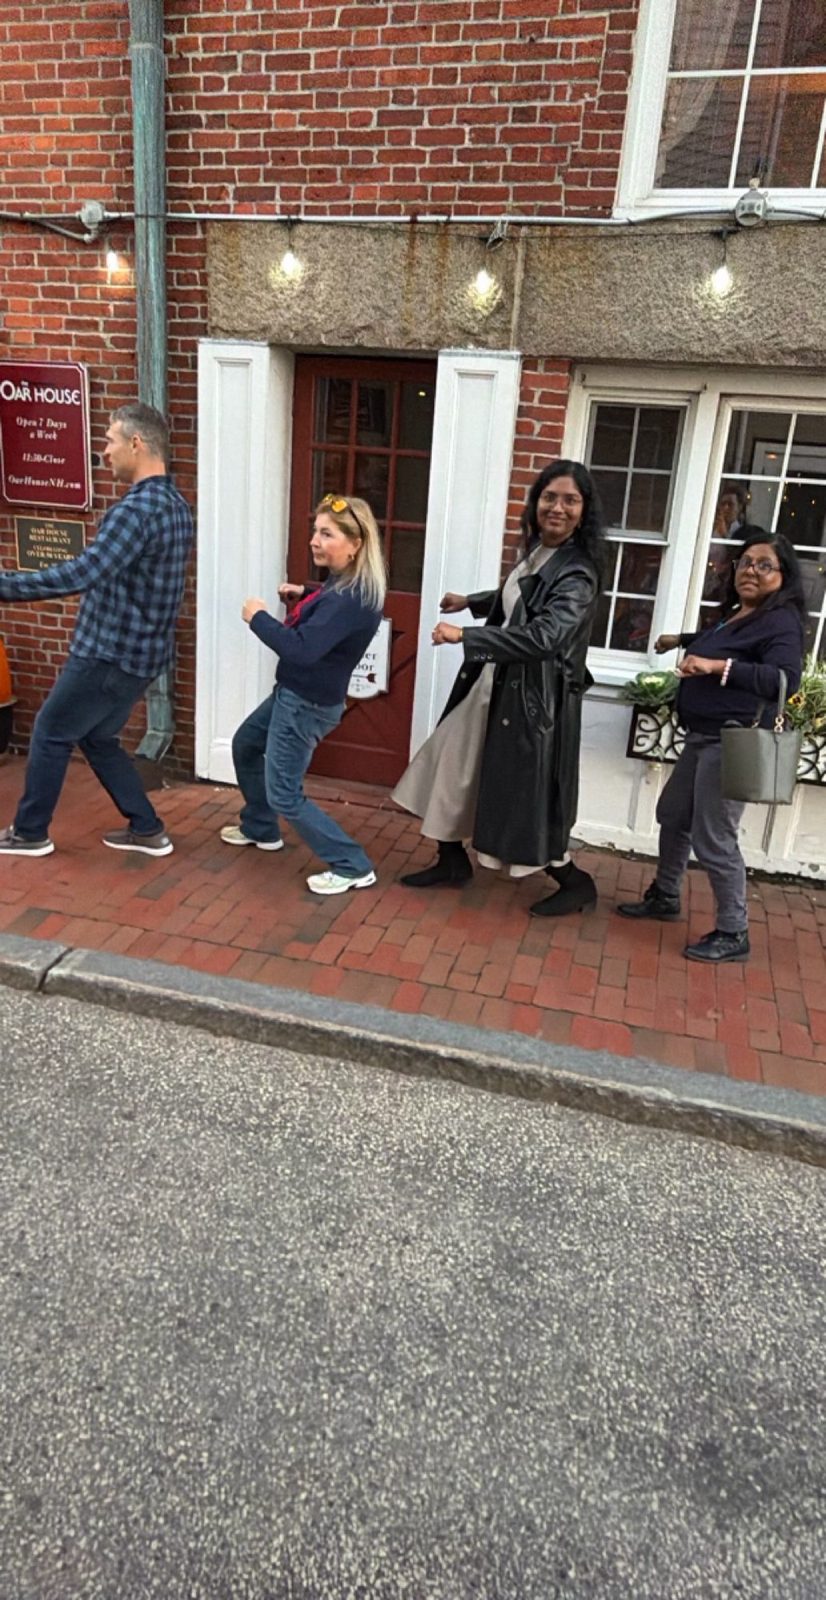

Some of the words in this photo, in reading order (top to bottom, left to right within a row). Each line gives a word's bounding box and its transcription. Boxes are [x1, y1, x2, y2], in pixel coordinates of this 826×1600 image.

[0, 380, 32, 402] OAR
[34, 387, 81, 406] HOUSE
[16, 416, 37, 428] Open
[39, 418, 43, 426] 7
[46, 418, 67, 430] Days
[37, 430, 57, 440] Week
[8, 475, 81, 489] OarHouseNH.com
[29, 535, 71, 544] RESTAURANT
[355, 663, 374, 671] oor
